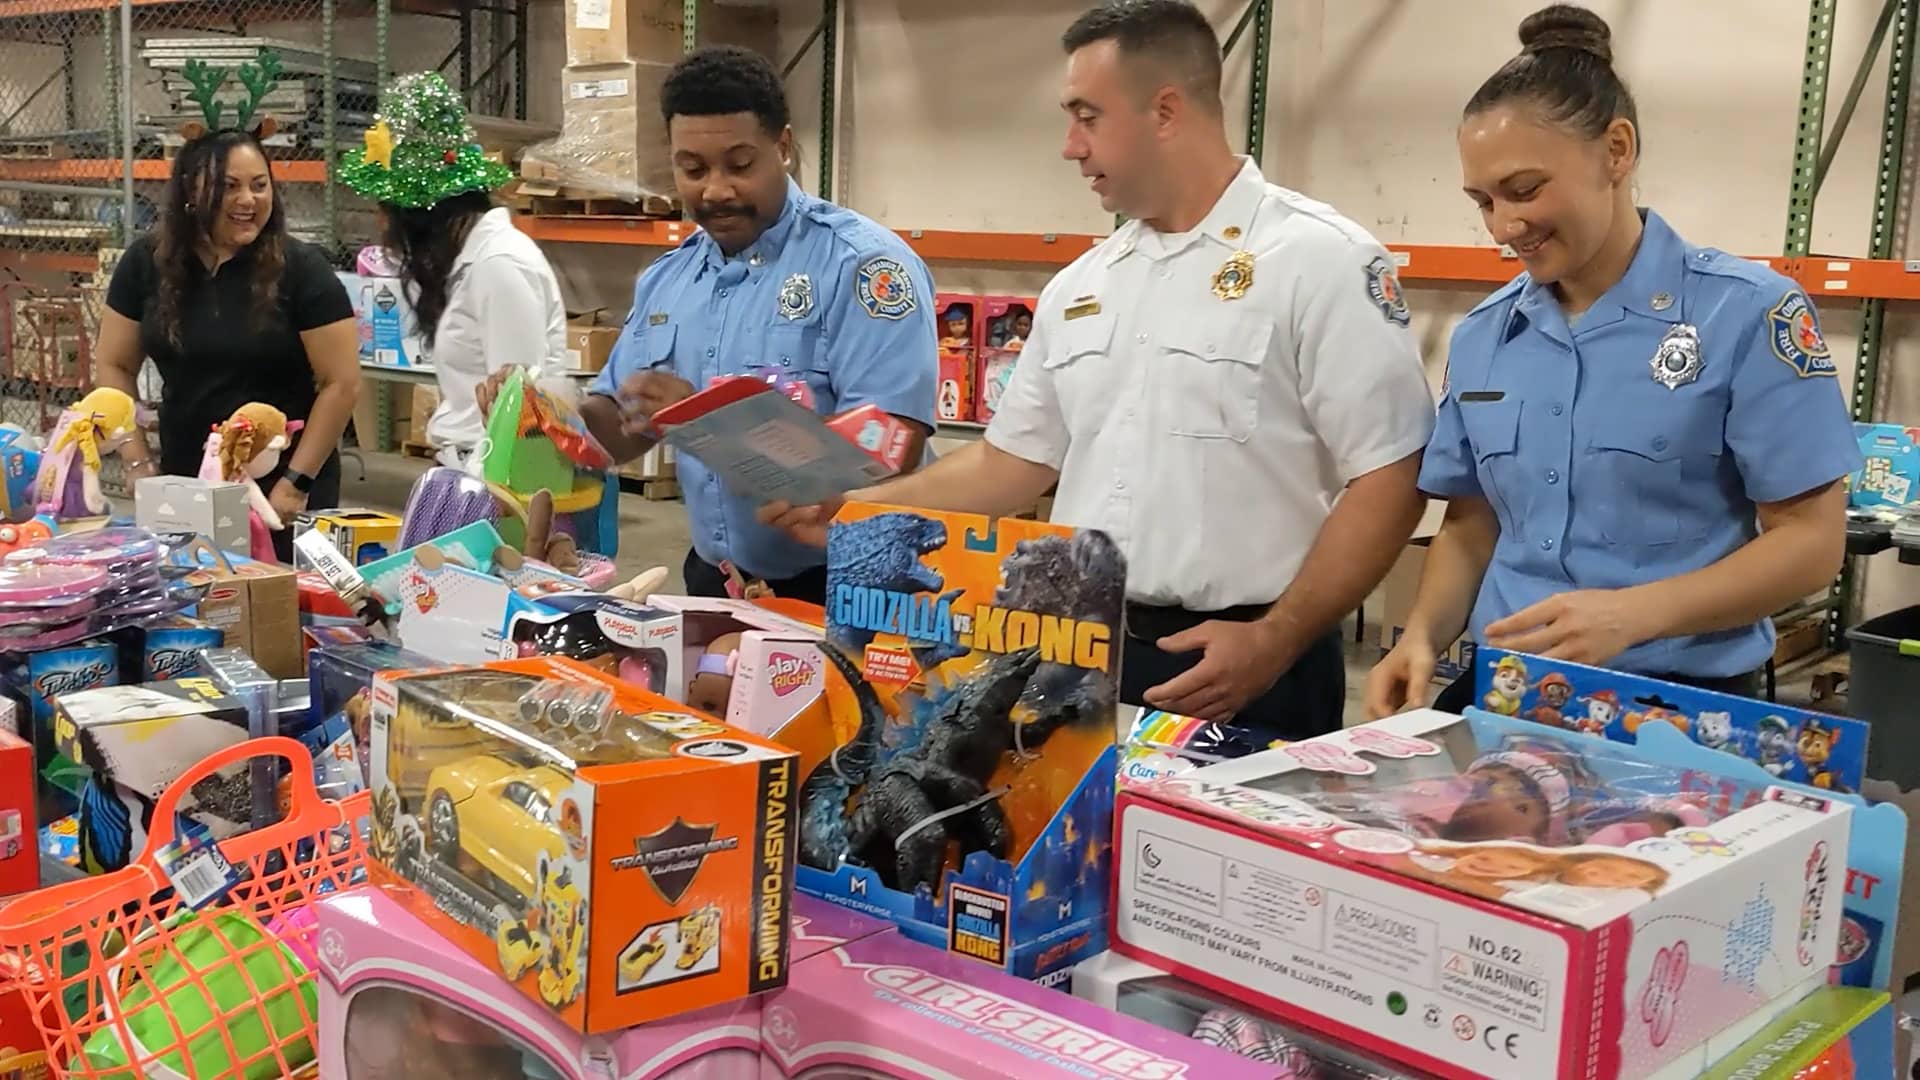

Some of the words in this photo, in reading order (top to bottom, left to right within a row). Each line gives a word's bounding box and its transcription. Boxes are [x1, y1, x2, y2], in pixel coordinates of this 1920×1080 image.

[1778, 327, 1801, 361] FIRE
[835, 583, 951, 644] GODZILLA
[973, 604, 1110, 673] KONG
[868, 651, 889, 664] TRY
[773, 670, 816, 689] RIGHT
[611, 837, 738, 871] TRANSFORMING
[759, 759, 790, 982] TRANSFORMING
[955, 932, 1001, 961] KONG
[1133, 899, 1212, 935] SPECIFICATIONS
[1213, 926, 1261, 951] COLOURS
[1132, 912, 1152, 928] AND
[1154, 917, 1206, 947] CONTENTS
[1207, 937, 1229, 954] MAY
[1230, 943, 1258, 964] VARY
[1258, 956, 1289, 977] FROM
[1290, 967, 1375, 1007] ILLUSTRATIONS
[871, 967, 992, 1021] GIRL
[983, 1010, 1182, 1080] SERIES
